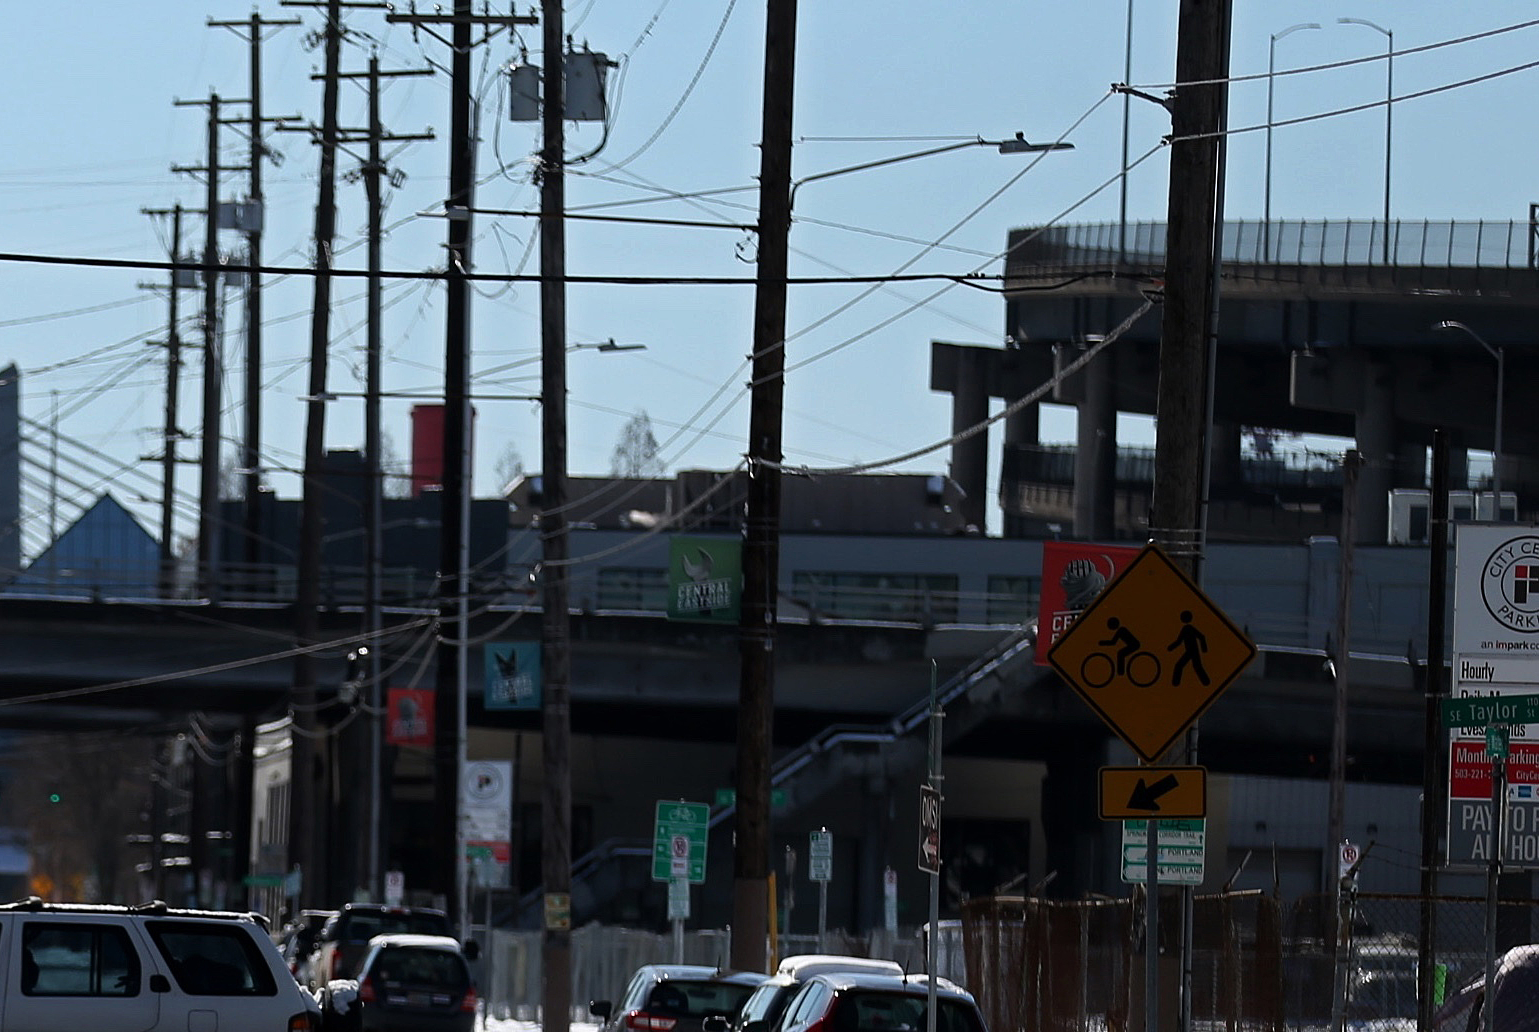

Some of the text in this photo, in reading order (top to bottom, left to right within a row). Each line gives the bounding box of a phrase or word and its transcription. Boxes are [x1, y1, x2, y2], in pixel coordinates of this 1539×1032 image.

[1490, 546, 1515, 578] CITY
[678, 581, 730, 599] CENTRAL
[1481, 641, 1493, 649] an
[1461, 661, 1494, 683] Hourly
[1450, 702, 1535, 722] SE Taylor St
[1456, 747, 1539, 768] Month arking
[922, 795, 938, 830] OMSI
[1167, 848, 1203, 857] PORTLAND
[1167, 866, 1202, 875] PORTLAND
